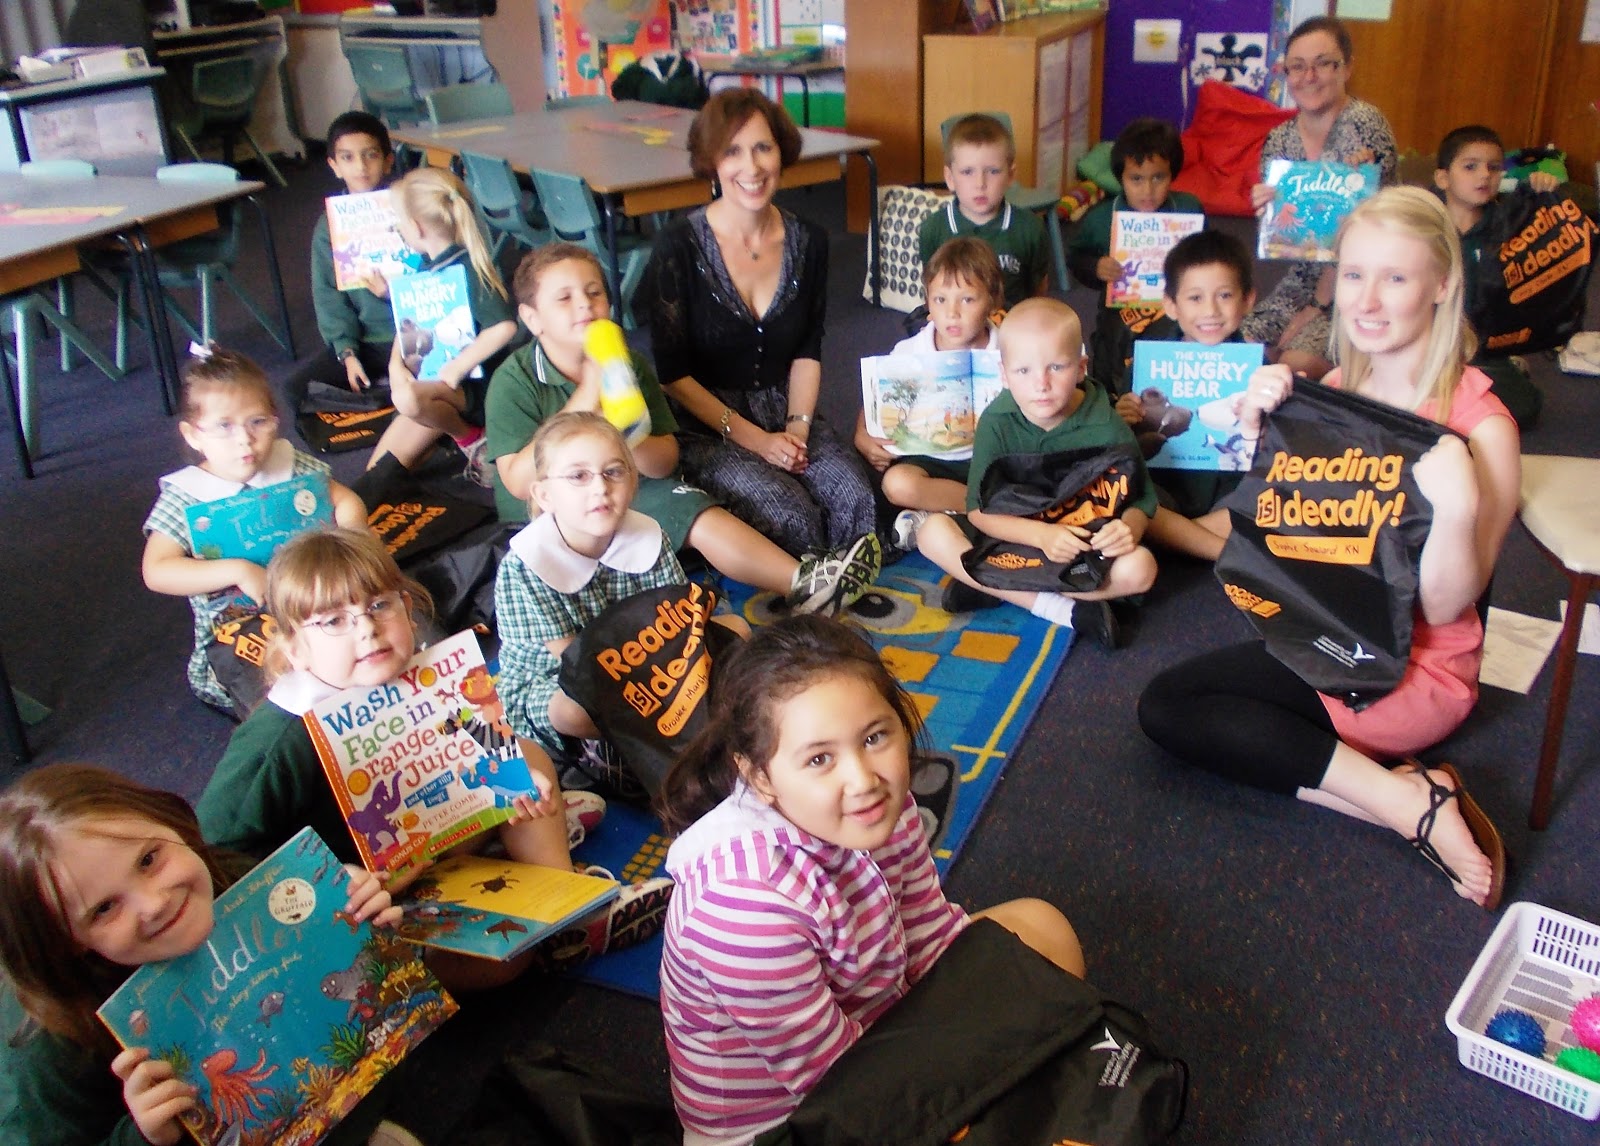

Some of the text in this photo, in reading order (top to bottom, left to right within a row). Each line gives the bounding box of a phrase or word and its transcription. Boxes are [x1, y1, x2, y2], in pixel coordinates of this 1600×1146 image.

[1121, 218, 1160, 234] Wash
[1123, 234, 1155, 248] Face
[1500, 199, 1582, 262] Reading
[1523, 215, 1600, 276] deadly!
[1150, 360, 1249, 381] HUNGRY
[1175, 351, 1225, 361] THE VERY
[1172, 381, 1221, 399] BEAR
[1266, 447, 1405, 492] Reading
[1283, 489, 1406, 527] deadly!
[323, 647, 466, 737] Wash Your
[342, 698, 436, 766] Face in
[405, 738, 476, 787] Juice
[422, 807, 449, 829] PETER
[389, 845, 414, 867] BONUS
